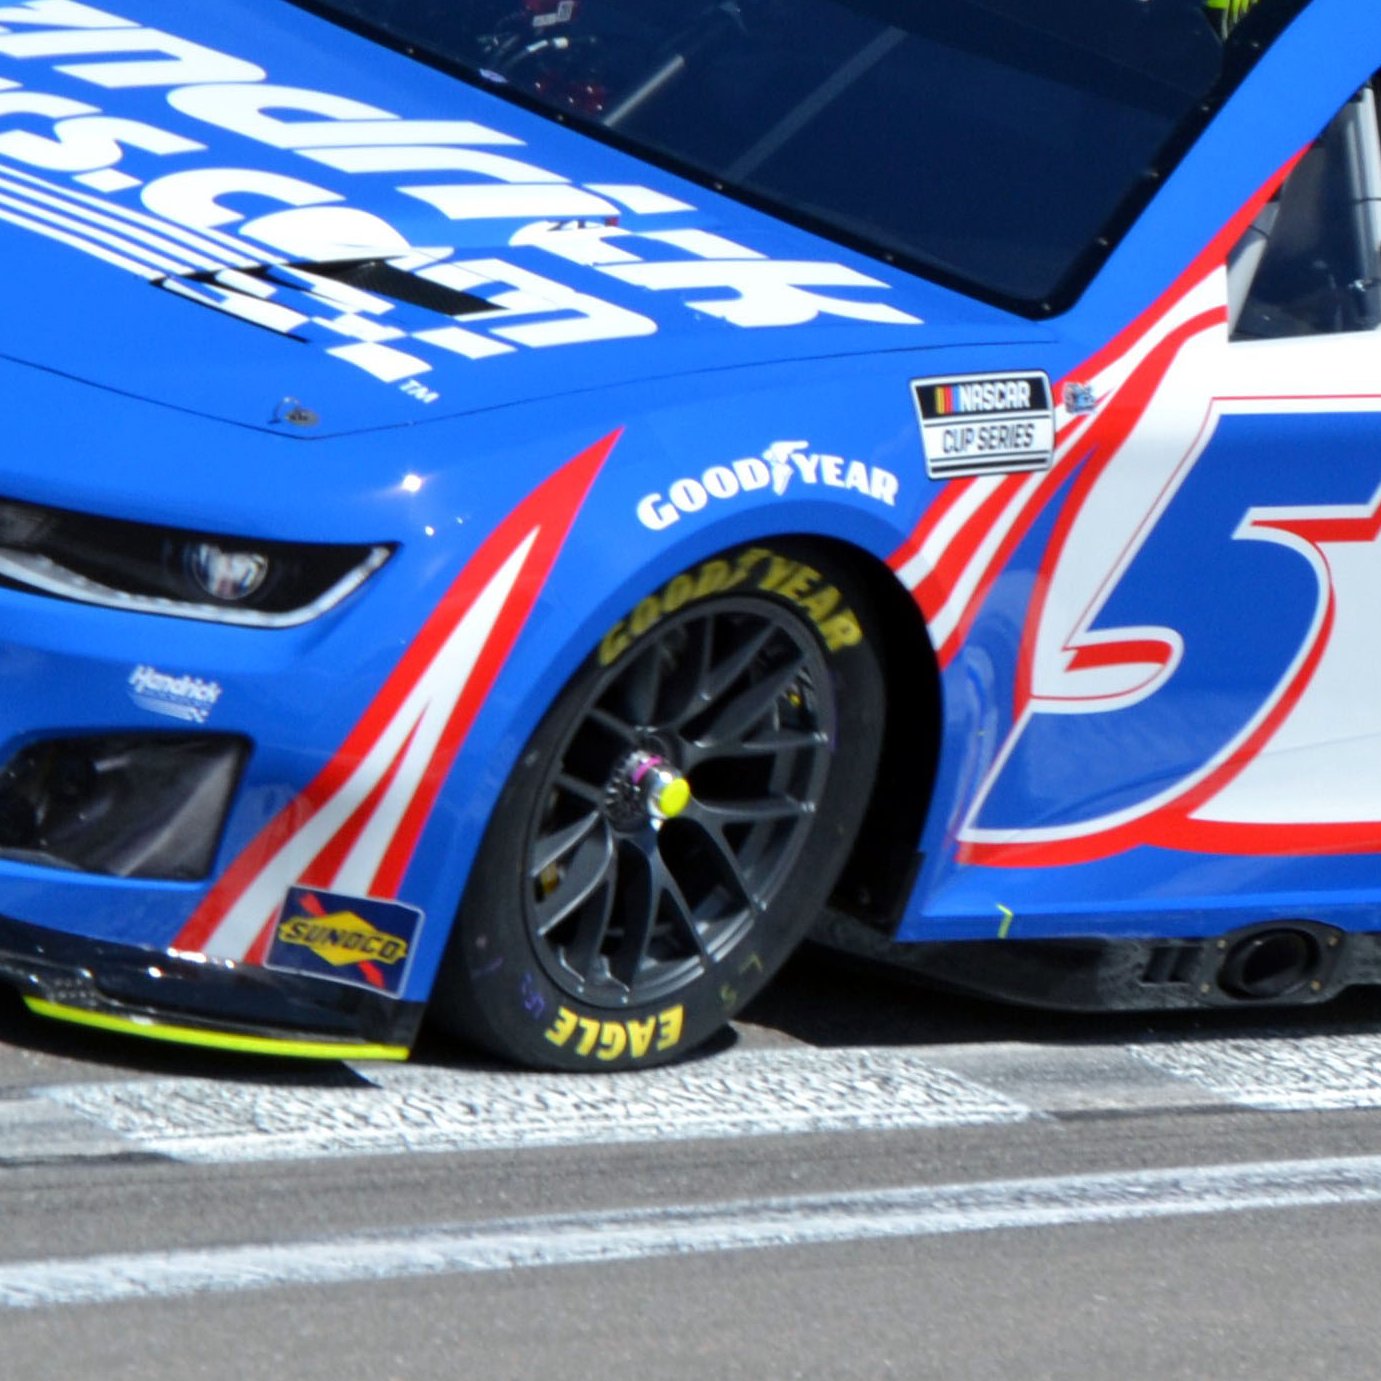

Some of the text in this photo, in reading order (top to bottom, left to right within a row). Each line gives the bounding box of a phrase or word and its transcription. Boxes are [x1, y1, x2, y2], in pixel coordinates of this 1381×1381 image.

[958, 379, 1031, 413] NASCAR
[942, 422, 1036, 454] CUP SERIES
[636, 440, 900, 530] GOODYEAR
[128, 665, 222, 704] Hendrick
[283, 920, 402, 962] SUNOCO
[543, 1004, 685, 1061] EAGLE
